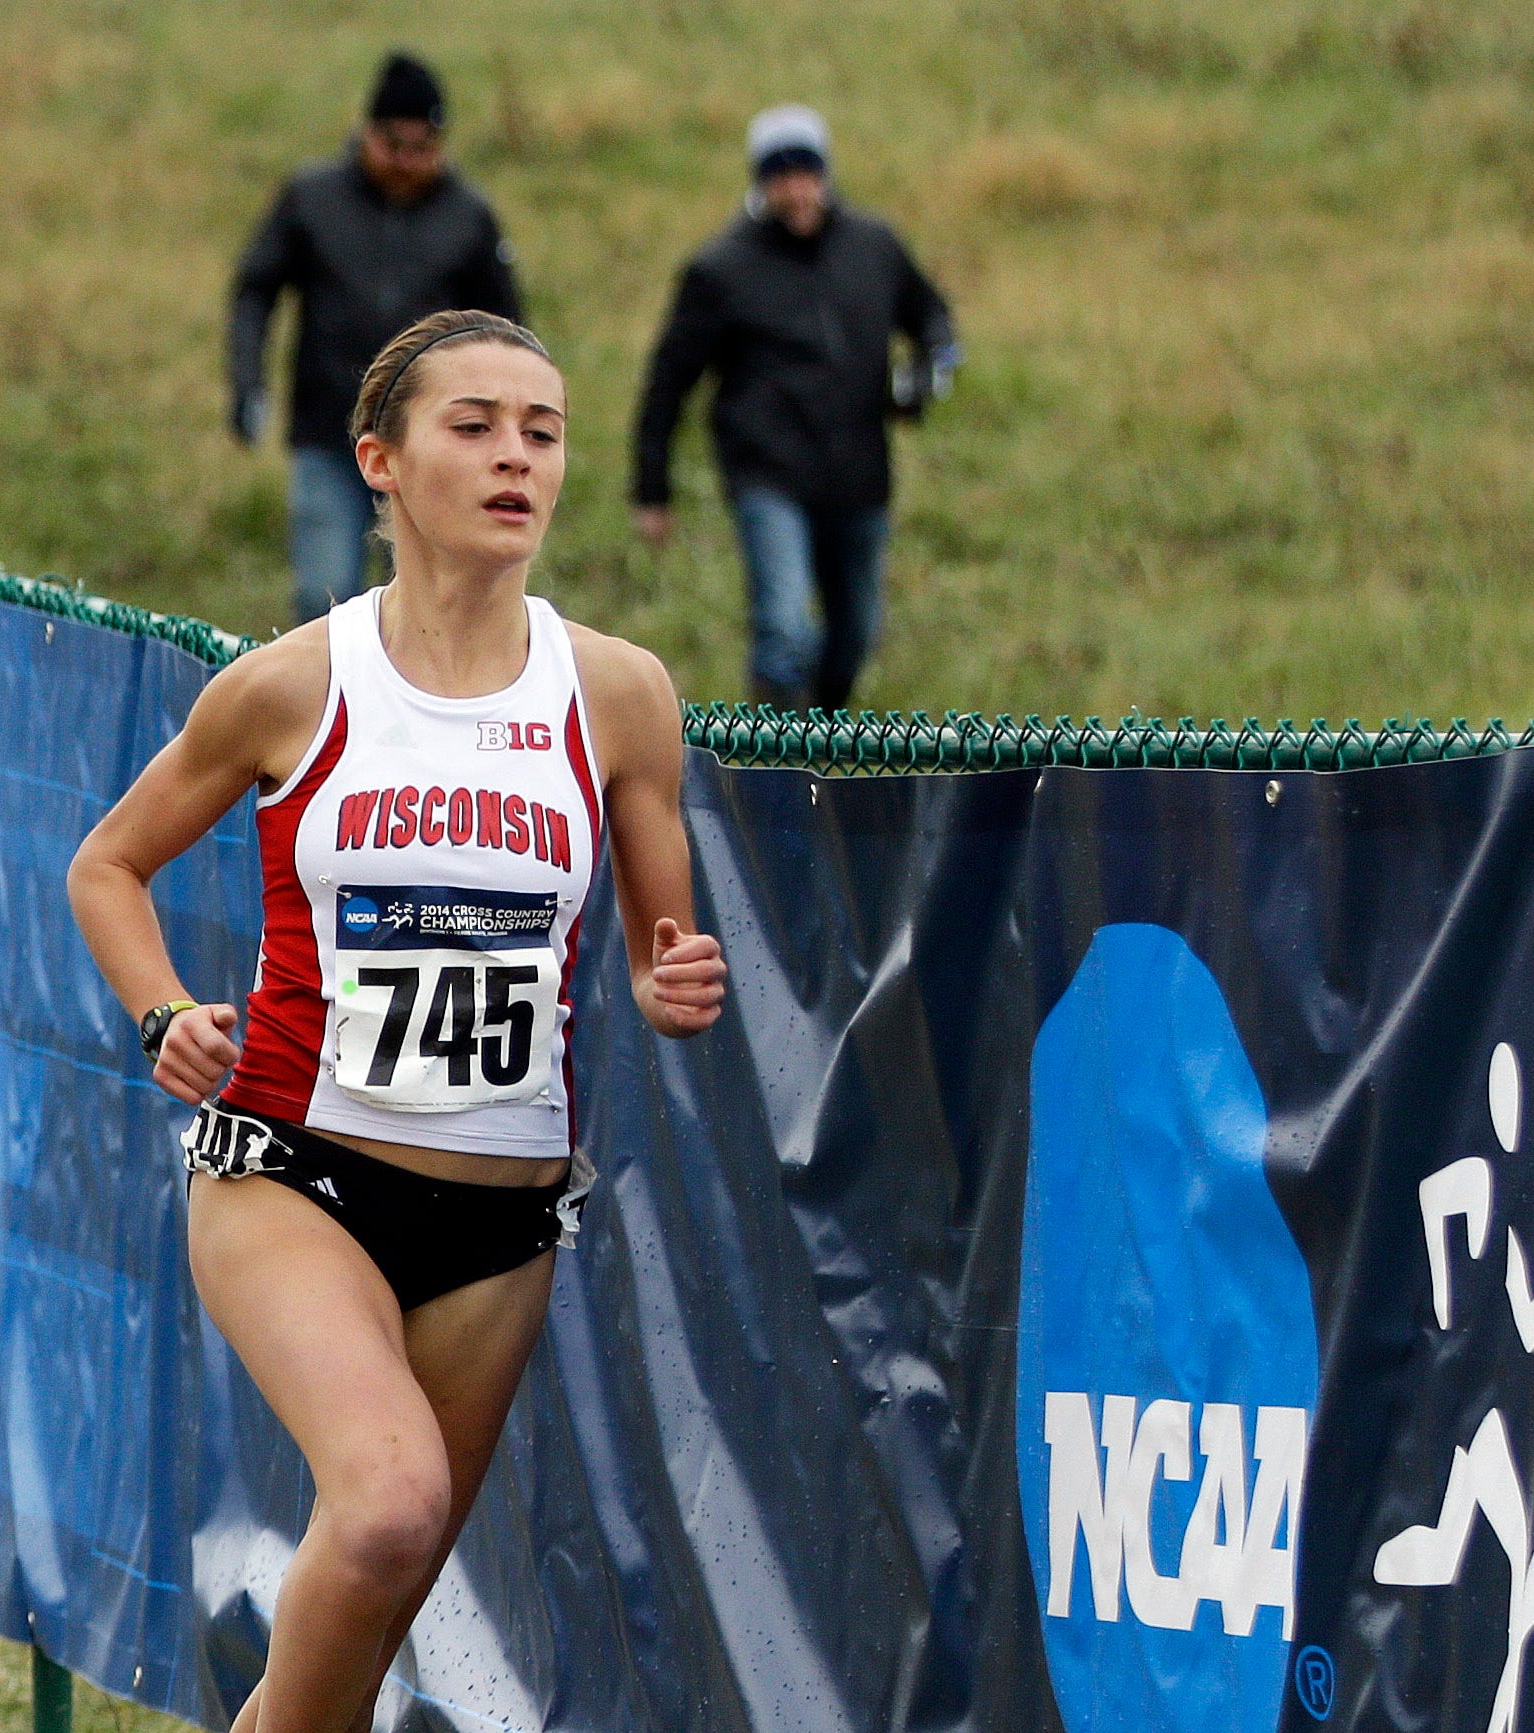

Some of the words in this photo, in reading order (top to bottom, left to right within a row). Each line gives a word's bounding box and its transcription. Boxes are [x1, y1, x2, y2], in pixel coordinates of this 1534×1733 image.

[335, 785, 572, 873] WISCONSIN
[345, 913, 378, 924] NCAA
[419, 916, 551, 931] CHAMPIONSHIPS
[420, 905, 450, 916] 2014
[453, 905, 492, 917] CROSS
[496, 909, 555, 919] COUNTRY
[358, 965, 539, 1087] 745
[1044, 1391, 1306, 1642] NCAA
